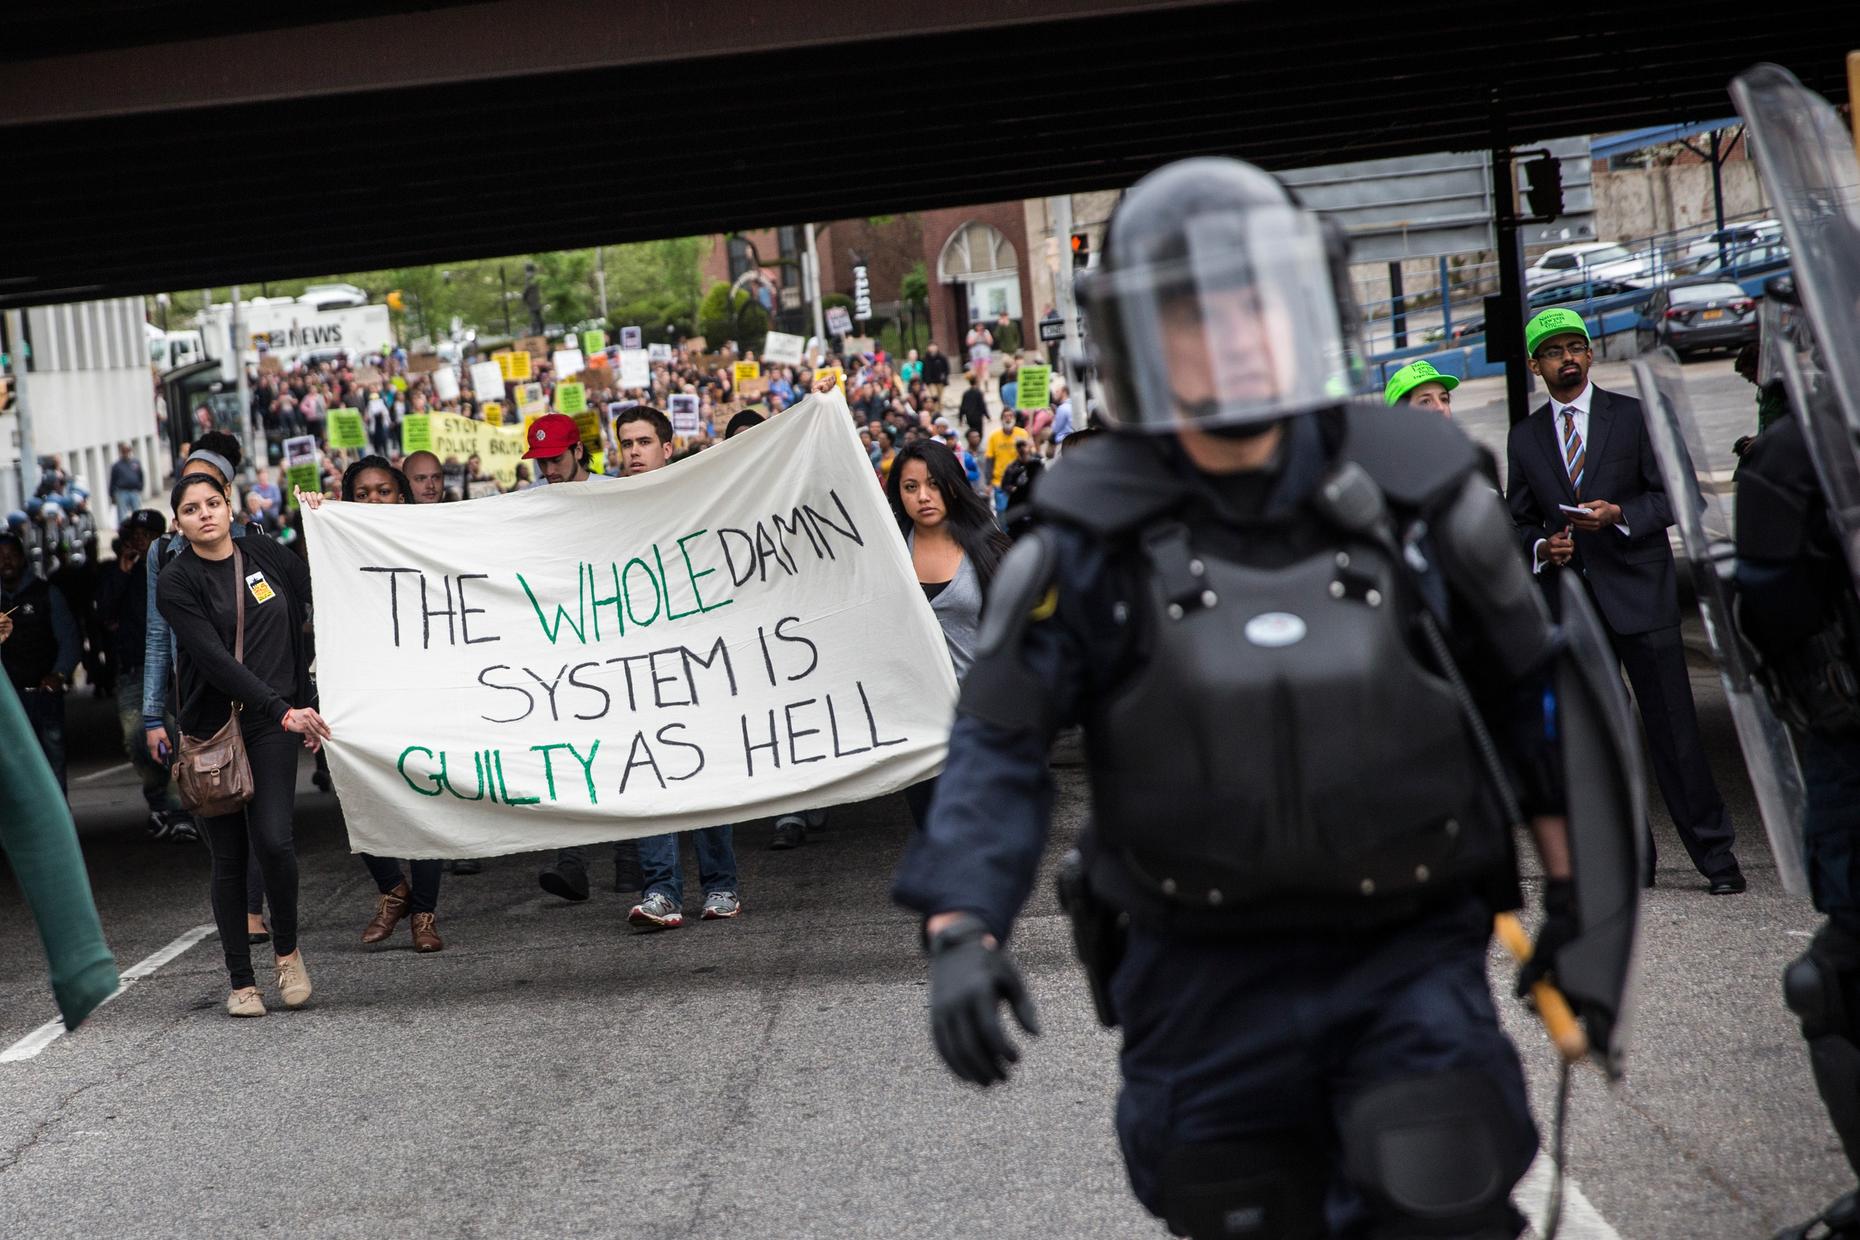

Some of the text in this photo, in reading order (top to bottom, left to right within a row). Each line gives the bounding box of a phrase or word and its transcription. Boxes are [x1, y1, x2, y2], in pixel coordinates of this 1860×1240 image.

[289, 325, 342, 347] NEWS
[360, 489, 864, 649] THE WHOLE DAMN
[478, 616, 818, 723] SYSTEM IS
[397, 681, 908, 805] GUILTY AS HELL
